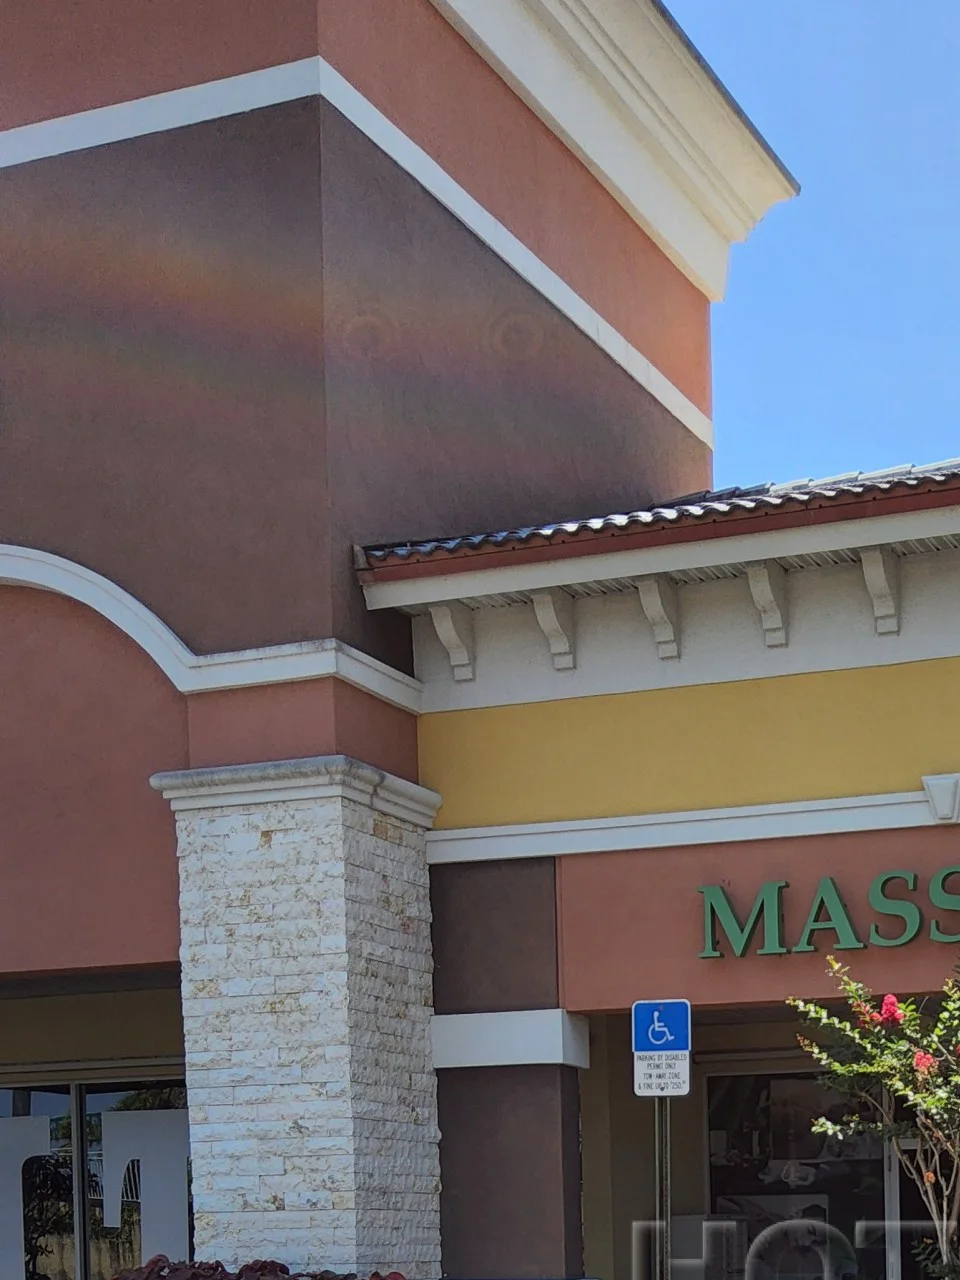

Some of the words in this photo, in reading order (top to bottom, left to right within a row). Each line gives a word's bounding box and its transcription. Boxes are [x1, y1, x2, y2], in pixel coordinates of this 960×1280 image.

[637, 1054, 656, 1062] PARKING
[664, 1053, 687, 1061] DISABLED
[647, 1062, 663, 1070] PERMIT
[665, 1062, 676, 1070] ONLY
[668, 1072, 681, 1080] ZONE
[643, 1082, 654, 1090] FINE
